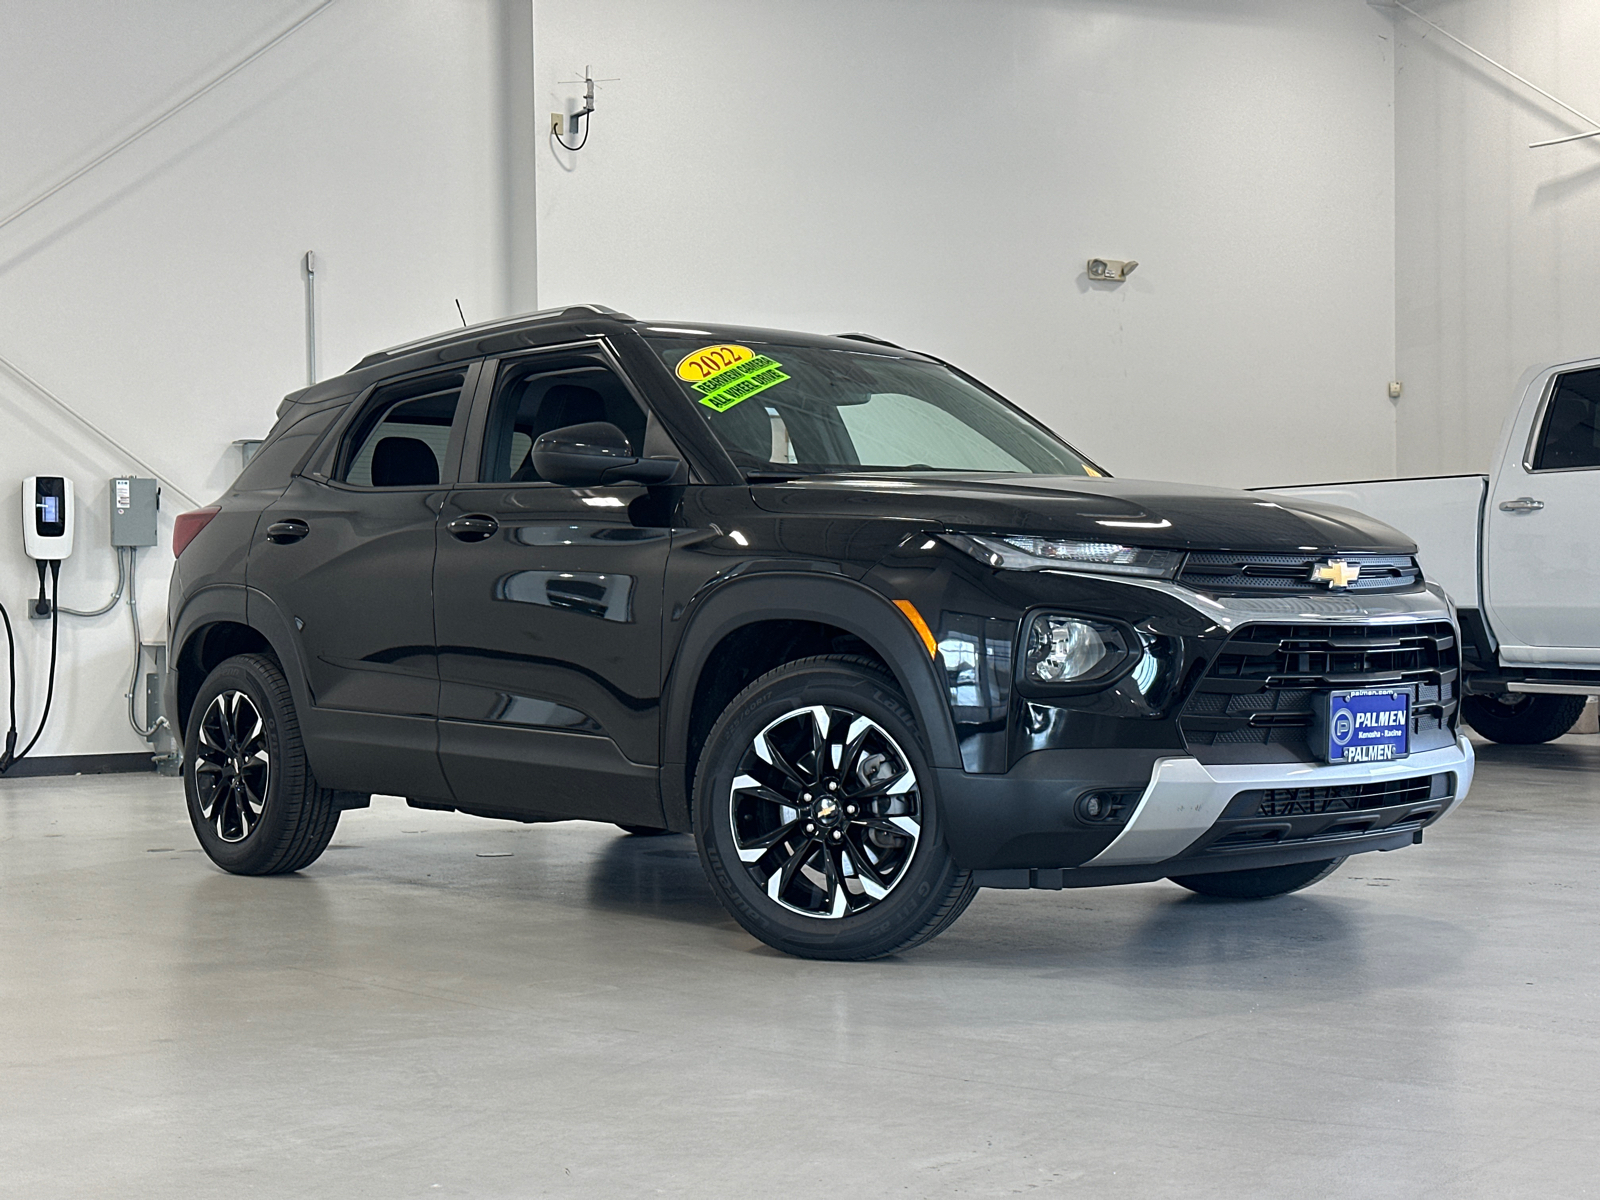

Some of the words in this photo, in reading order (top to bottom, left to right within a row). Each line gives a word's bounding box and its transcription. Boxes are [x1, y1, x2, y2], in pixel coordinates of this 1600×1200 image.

[689, 347, 742, 378] 2022
[697, 368, 746, 394] REARVIEW
[736, 356, 776, 375] CAMERA
[708, 393, 736, 408] ALL
[723, 379, 762, 399] WHEEL
[751, 369, 780, 386] DRIVE
[1355, 710, 1407, 728] PALMEN
[1358, 730, 1381, 739] Kenosha
[1384, 729, 1402, 738] Racine
[1348, 744, 1392, 763] PALMEN
[917, 880, 931, 898] G
